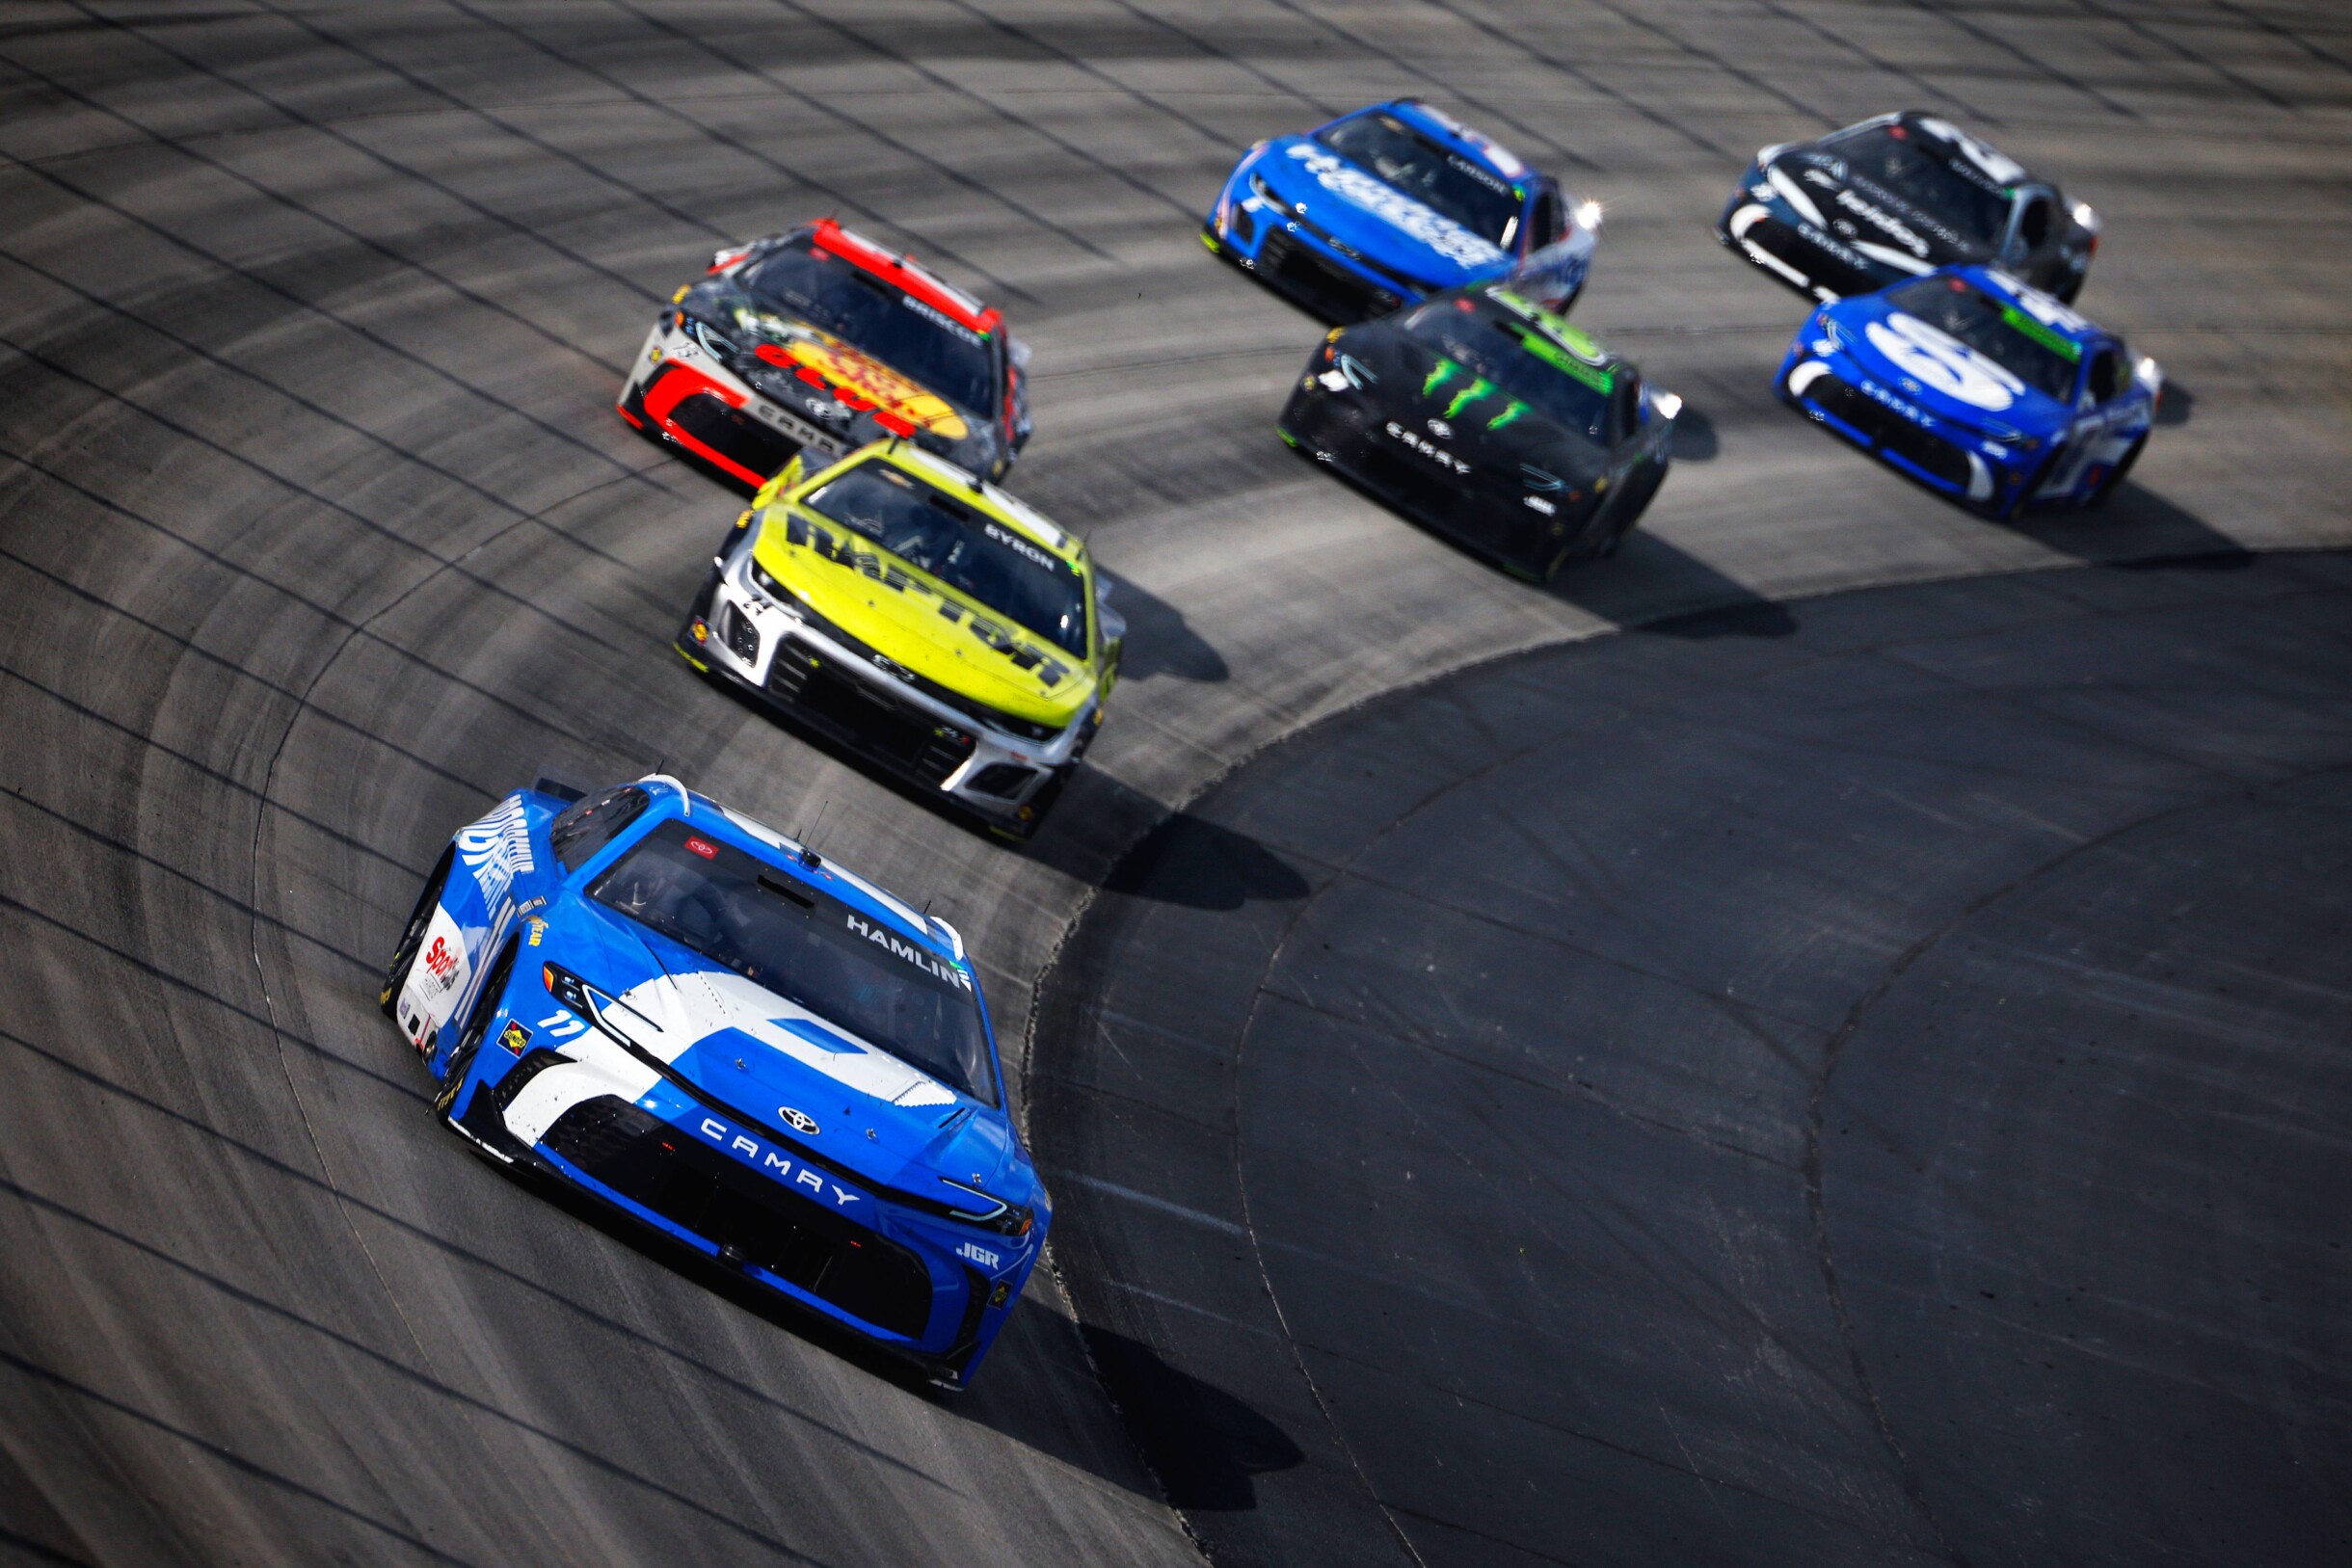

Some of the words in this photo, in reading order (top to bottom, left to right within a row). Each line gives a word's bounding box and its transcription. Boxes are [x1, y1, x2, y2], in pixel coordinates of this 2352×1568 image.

[758, 405, 835, 453] CAMR
[985, 523, 1055, 572] BYRON
[847, 914, 960, 989] HAMLIN
[504, 1029, 527, 1049] SUNOCO
[537, 1010, 585, 1037] 11
[700, 1117, 861, 1206] CAMRY
[955, 1241, 1000, 1270] JGR
